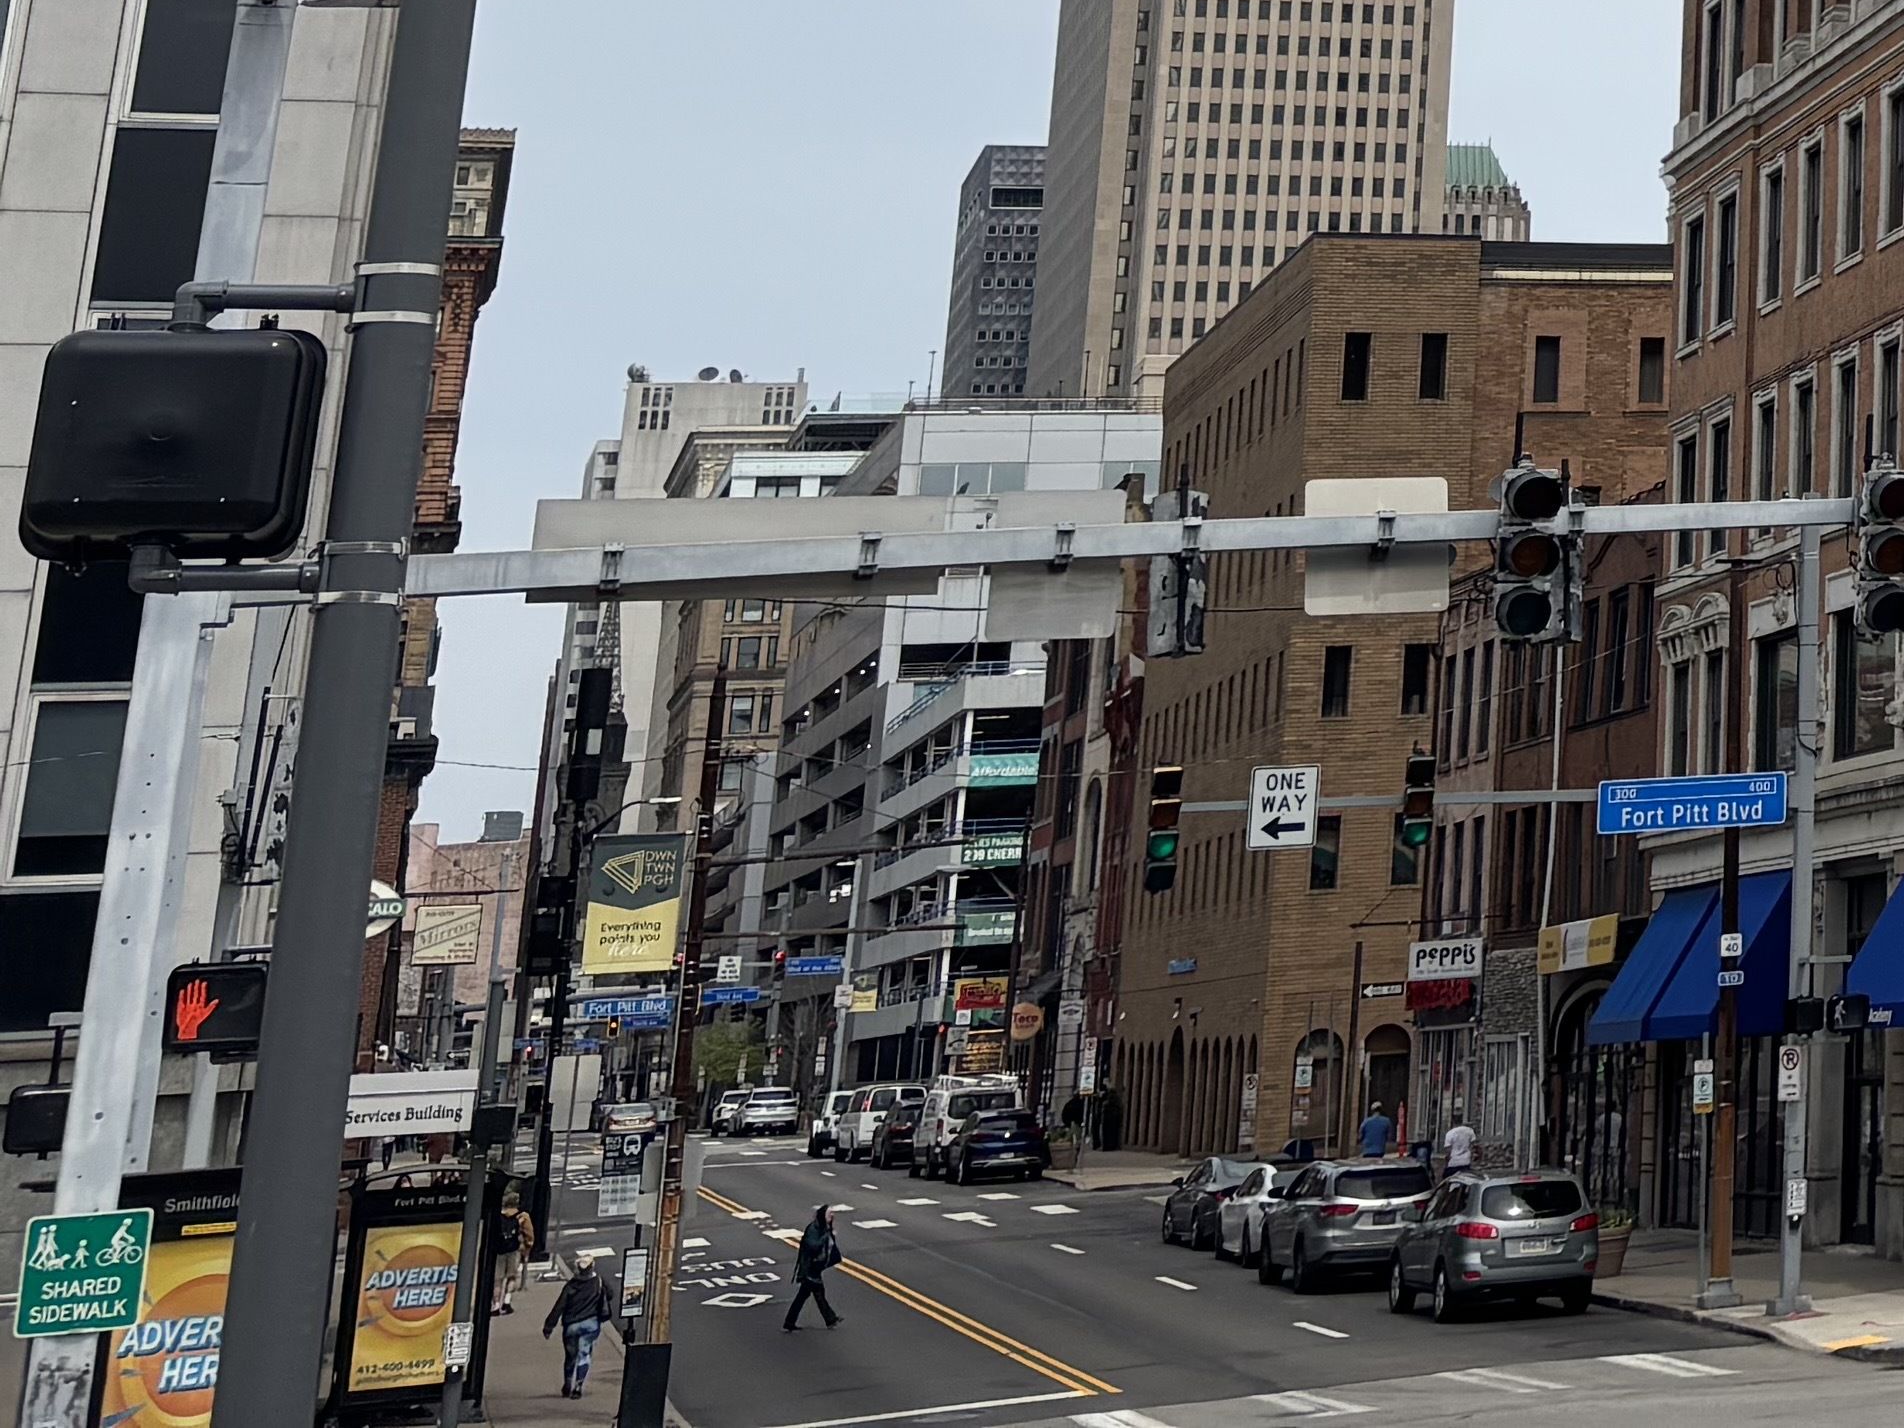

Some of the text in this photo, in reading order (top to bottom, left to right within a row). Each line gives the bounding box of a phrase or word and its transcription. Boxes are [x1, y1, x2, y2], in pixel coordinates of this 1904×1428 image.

[972, 764, 1039, 778] Affordable
[1266, 772, 1305, 791] ONE
[1615, 781, 1771, 800] 300 400
[1262, 793, 1308, 813] WAY
[1622, 800, 1762, 828] Fort Pitt Blvd
[645, 850, 677, 863] DWN
[646, 862, 676, 875] TWN
[643, 873, 674, 886] PGH
[419, 919, 478, 945] Mirrors
[601, 921, 661, 933] Everything
[600, 932, 660, 946] points you
[589, 1002, 612, 1014] Fort
[617, 1001, 636, 1012] Pitt
[345, 1105, 463, 1124] Services Building
[395, 1197, 414, 1208] Fort
[365, 1264, 458, 1291] ADVERTIS
[41, 1276, 121, 1300] SHARED
[392, 1287, 450, 1310] HERE
[28, 1298, 128, 1325] SIDEWALK
[117, 1315, 224, 1359] ADVER
